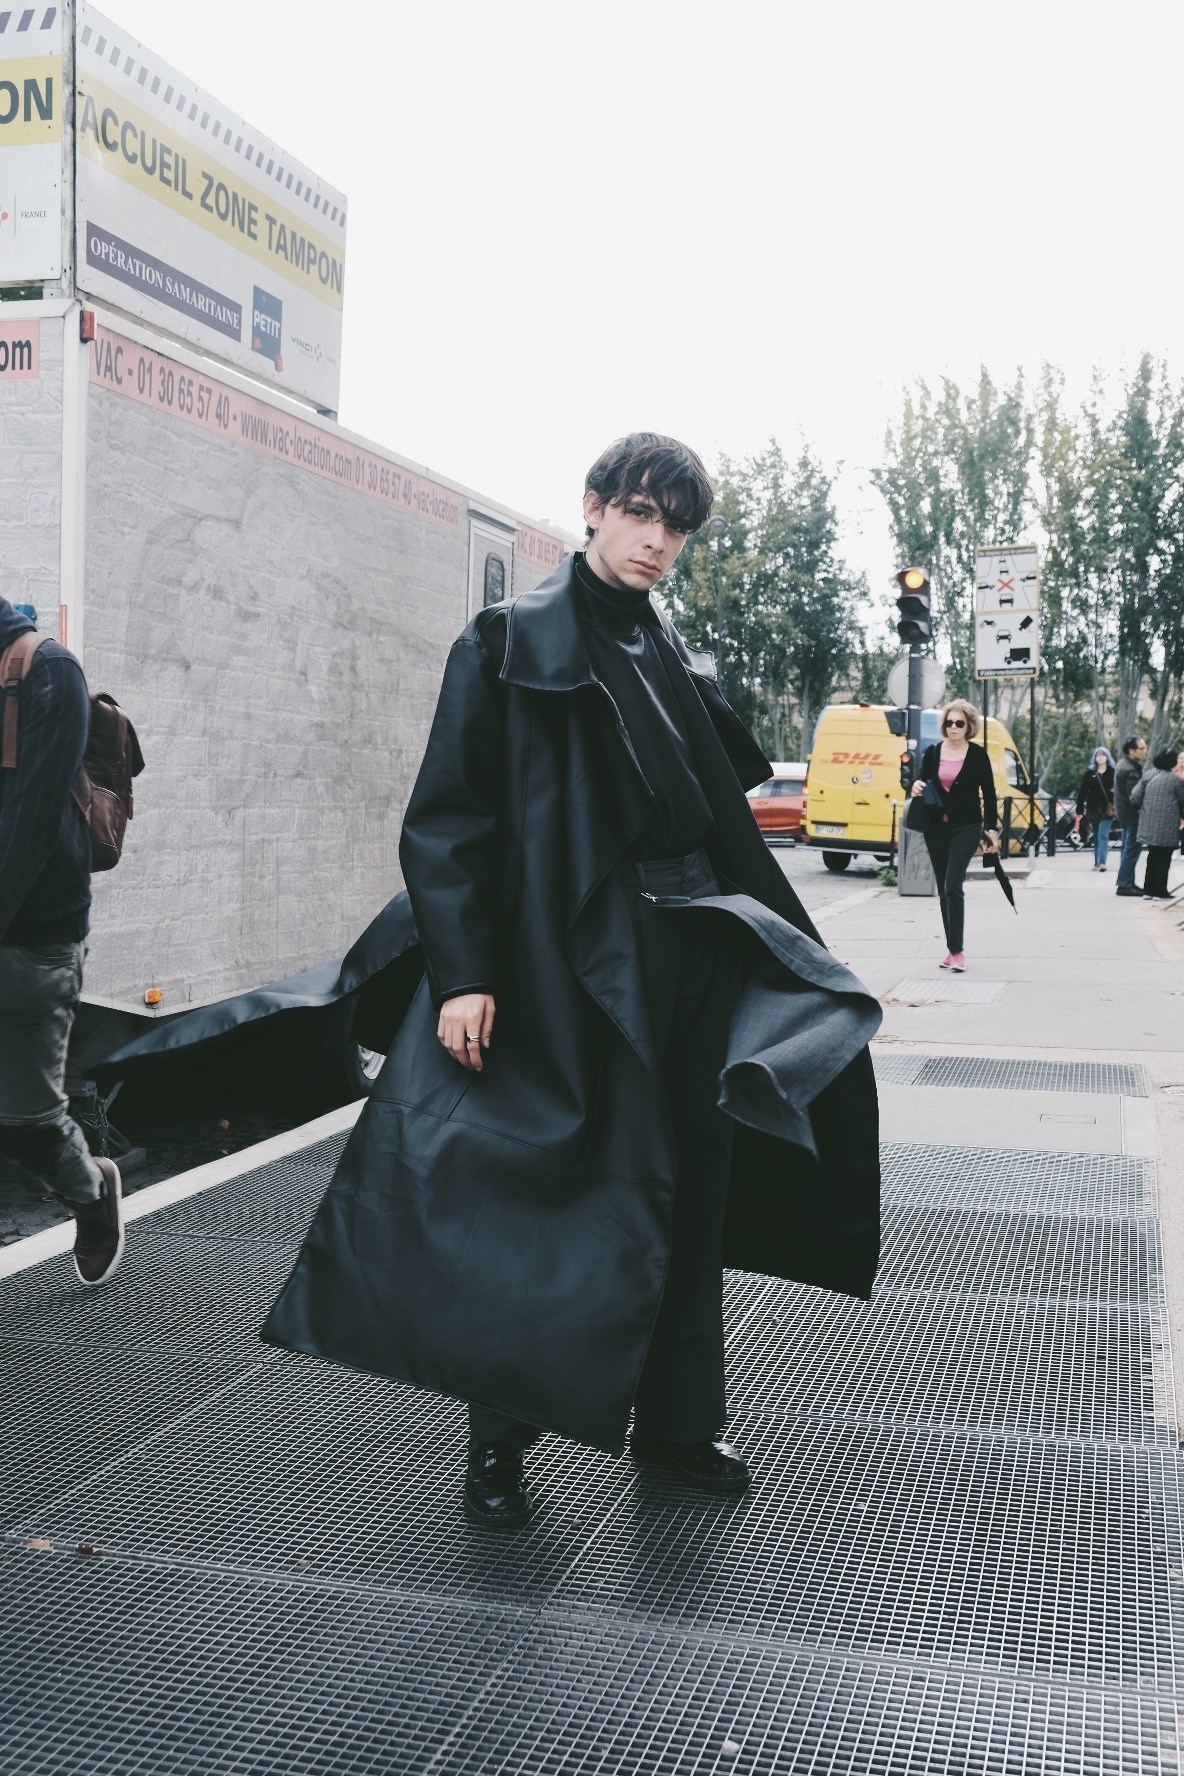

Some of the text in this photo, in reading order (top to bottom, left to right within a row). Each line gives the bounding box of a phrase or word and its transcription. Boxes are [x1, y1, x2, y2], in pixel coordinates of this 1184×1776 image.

[0, 77, 53, 124] ON
[20, 210, 47, 219] FRANCE
[80, 95, 343, 295] ACCUEIL ZONE TAMPON
[90, 237, 240, 330] OPÉRATION SAMARITAINE
[253, 309, 281, 339] PETIT
[290, 335, 313, 352] VINCI
[0, 340, 31, 372] om
[95, 338, 124, 385] VAC
[137, 357, 153, 398] 01
[158, 366, 174, 406] 30
[178, 375, 194, 415] 65
[197, 384, 213, 422] 57
[215, 392, 230, 430] 40
[241, 410, 352, 481] www.vac-location.com
[355, 456, 365, 486] 01
[367, 461, 378, 492] 30
[380, 466, 390, 497] 65
[391, 471, 401, 501] 57
[402, 477, 412, 506] 40
[830, 752, 885, 766] DHL
